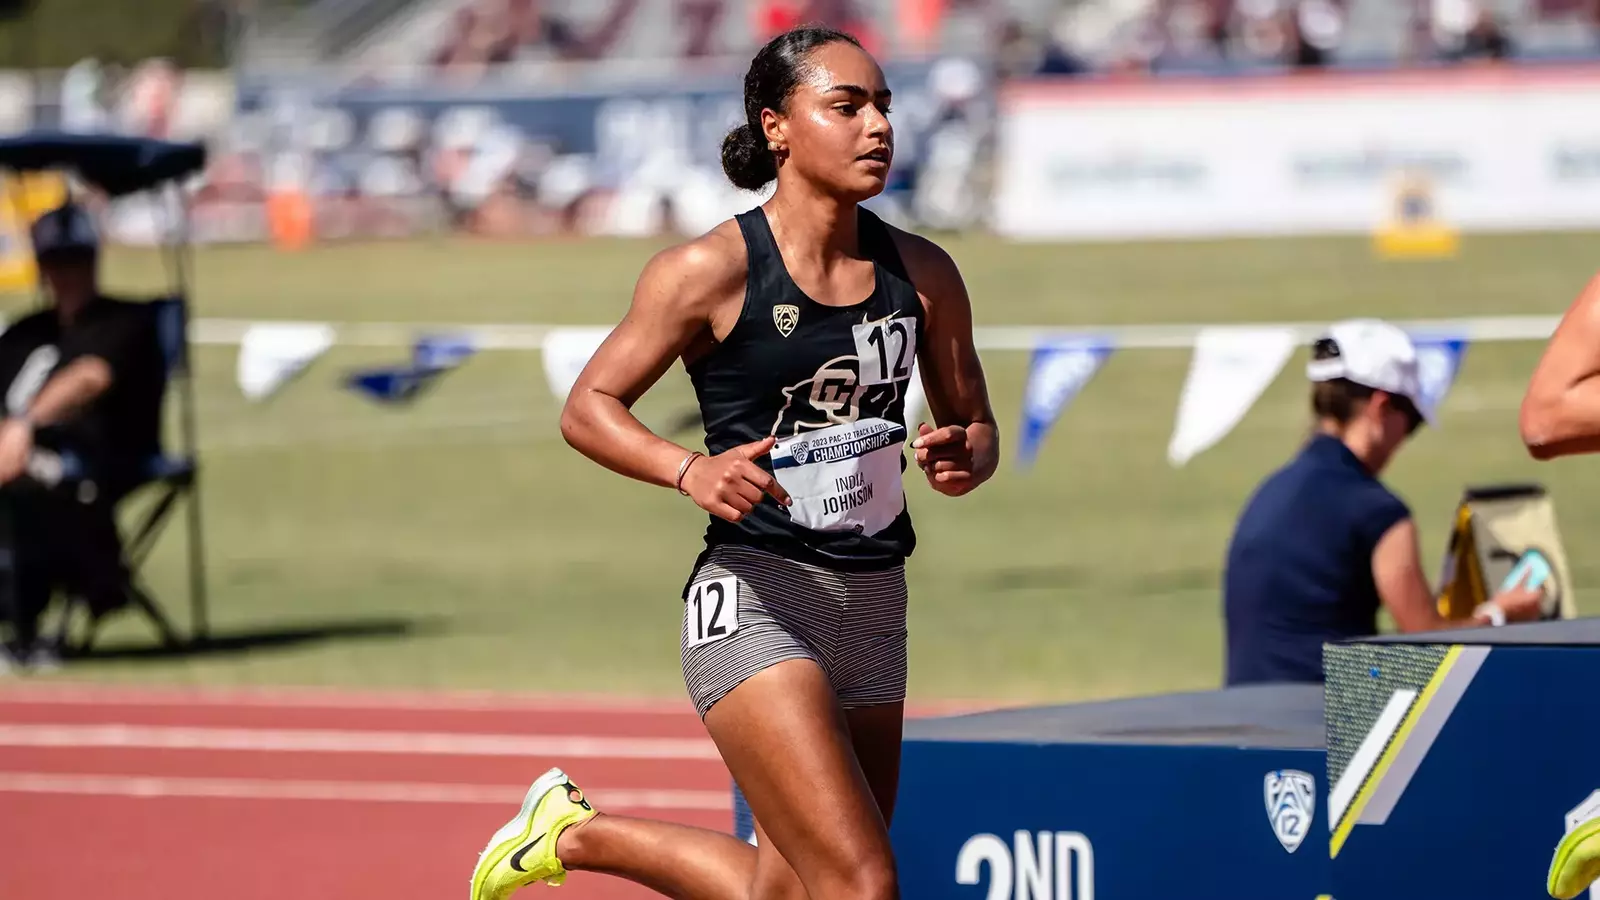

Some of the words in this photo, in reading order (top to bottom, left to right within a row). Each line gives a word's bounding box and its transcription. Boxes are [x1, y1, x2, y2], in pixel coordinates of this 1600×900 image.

[775, 306, 797, 322] PAC
[780, 319, 792, 330] 12
[867, 322, 908, 380] 12
[812, 438, 828, 447] 2023
[829, 432, 852, 444] PAC-12
[853, 428, 869, 439] TRACK
[875, 423, 889, 432] FIELD
[791, 442, 809, 456] PAC
[797, 453, 806, 462] 12
[813, 433, 890, 462] CHAMPIONSHIPS
[835, 472, 865, 492] INDIA
[823, 483, 874, 515] JOHNSON
[693, 581, 727, 640] 12
[1267, 774, 1314, 812] PAC
[1281, 815, 1300, 836] 12
[955, 830, 1095, 900] 2ND
